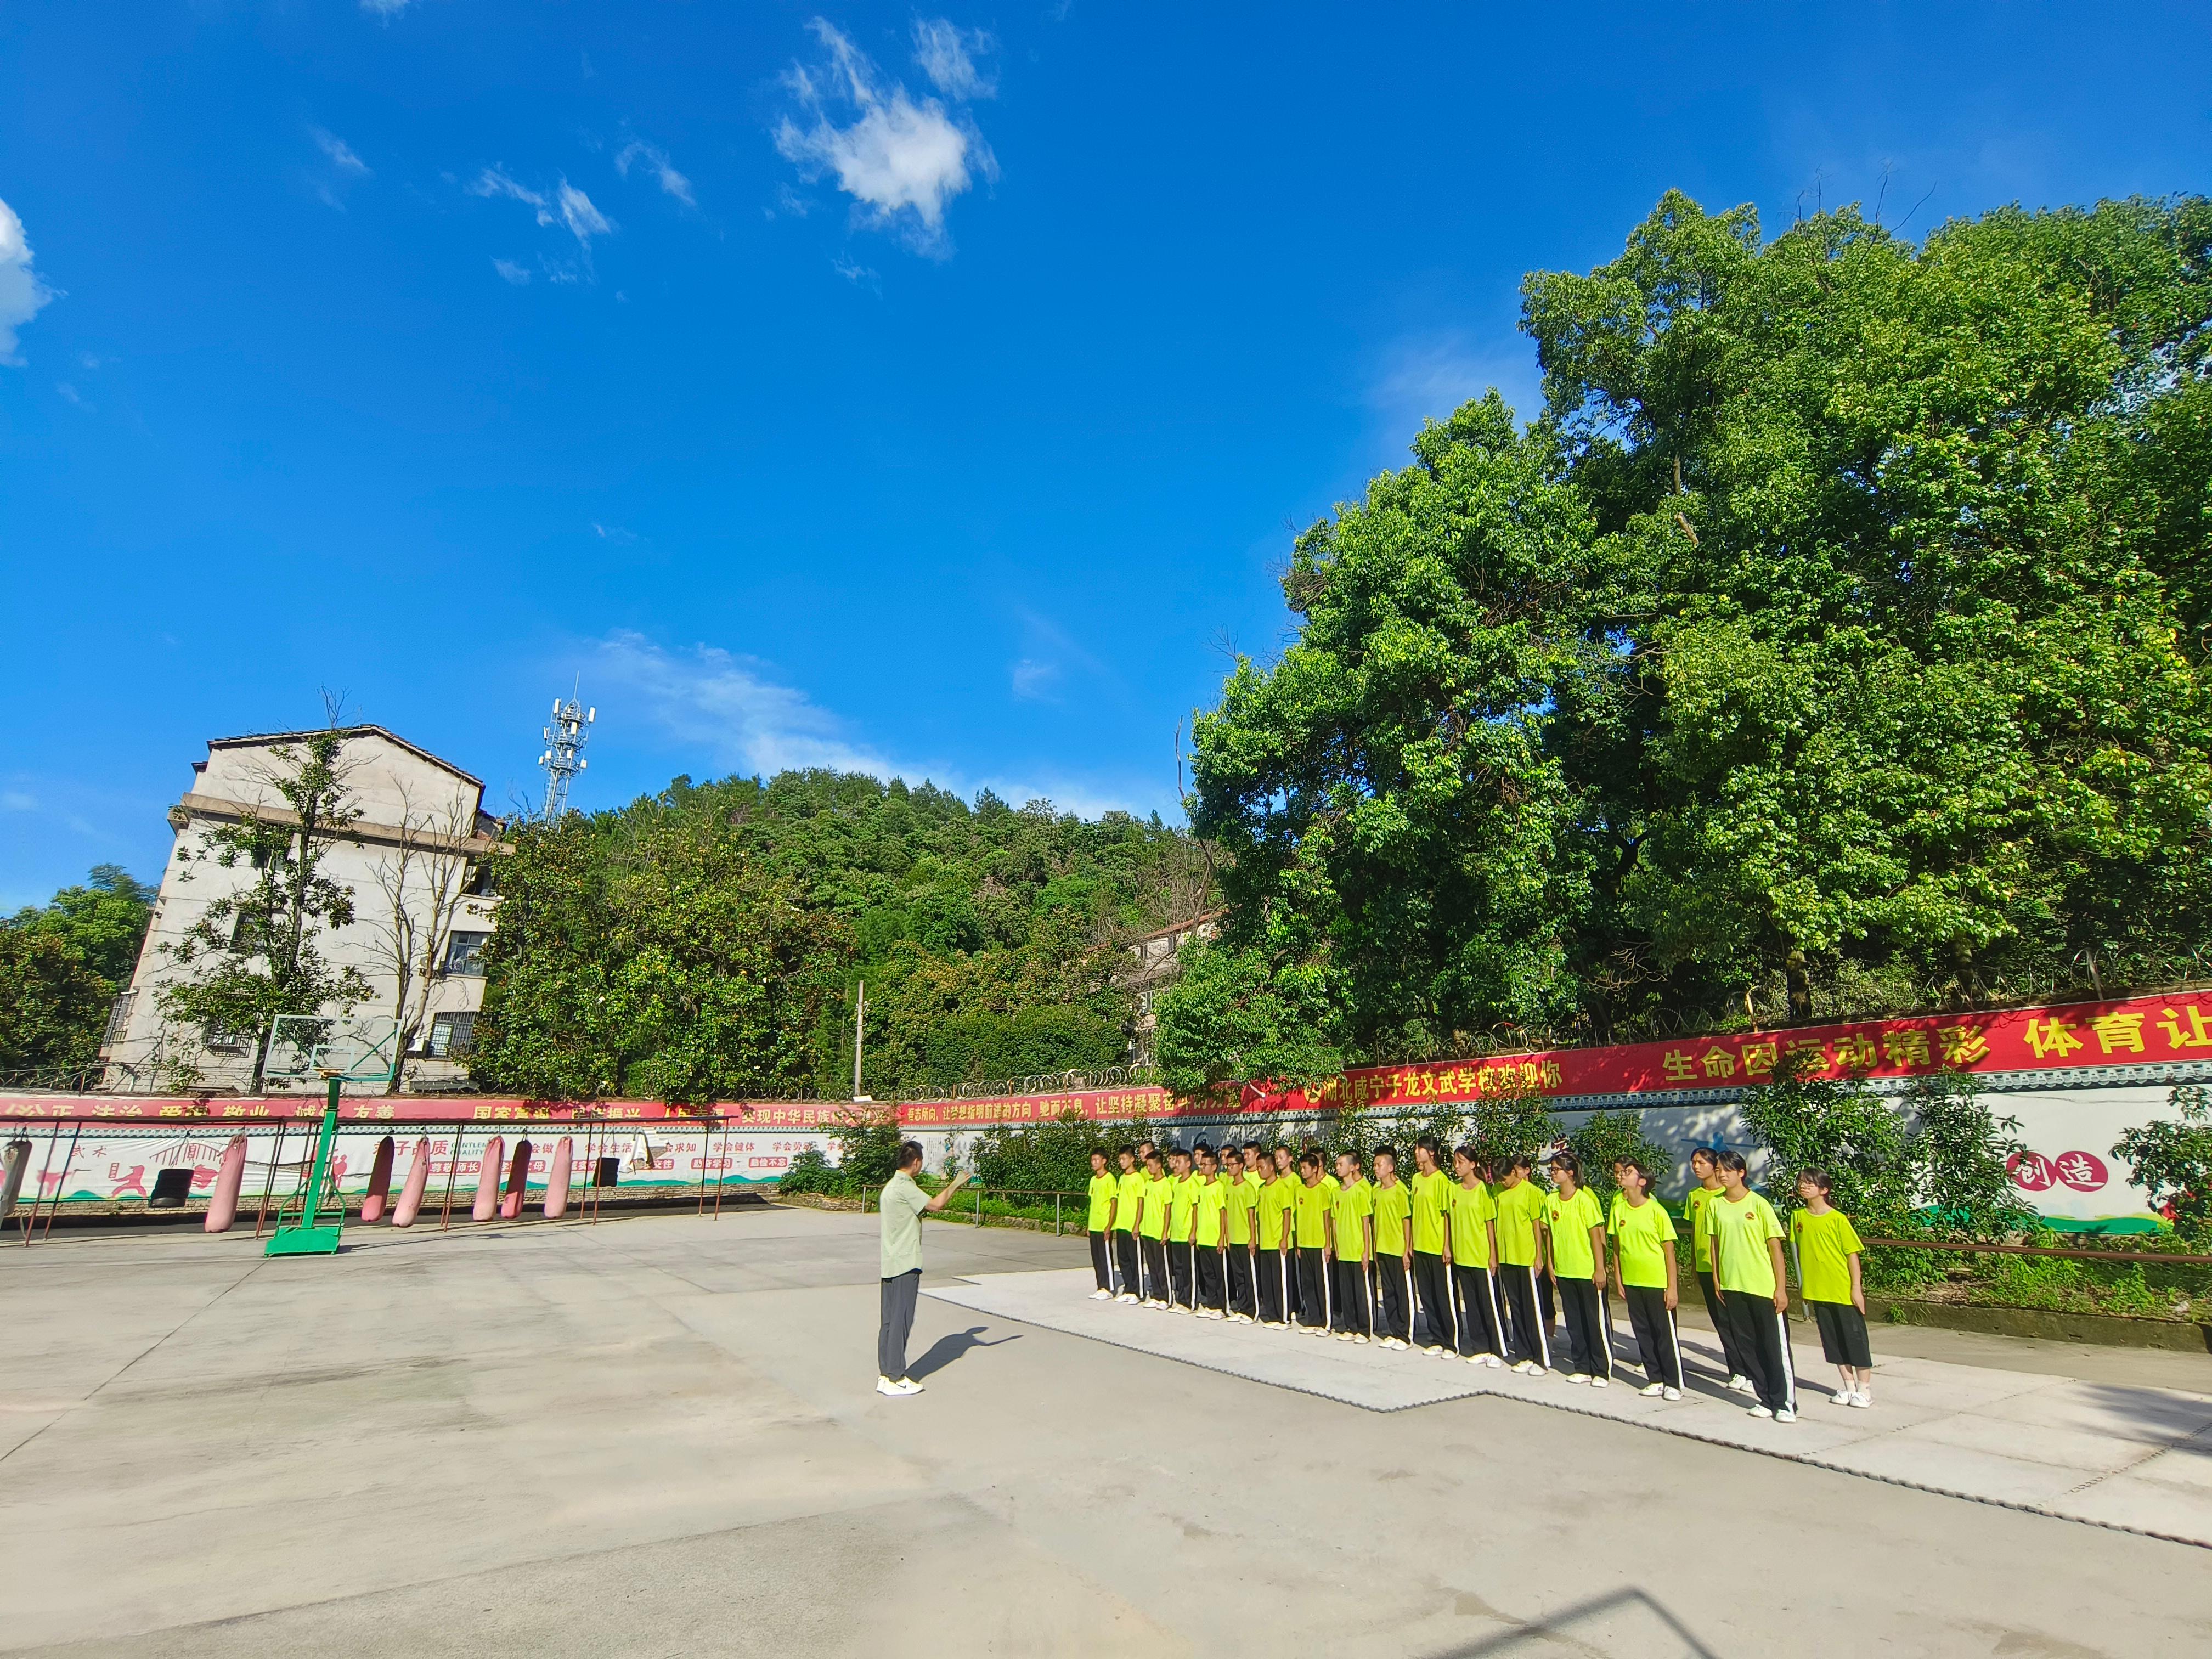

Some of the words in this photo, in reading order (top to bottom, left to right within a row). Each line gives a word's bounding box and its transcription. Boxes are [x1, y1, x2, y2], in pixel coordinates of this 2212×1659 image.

[1662, 1024, 1990, 1081] 生命因运动精彩
[2023, 1006, 2212, 1058] 体育让
[1323, 1059, 1563, 1102] 湖北咸宁子龙文武学校欢迎你
[665, 1142, 696, 1153] 会求知
[2014, 1154, 2106, 1187] 创造
